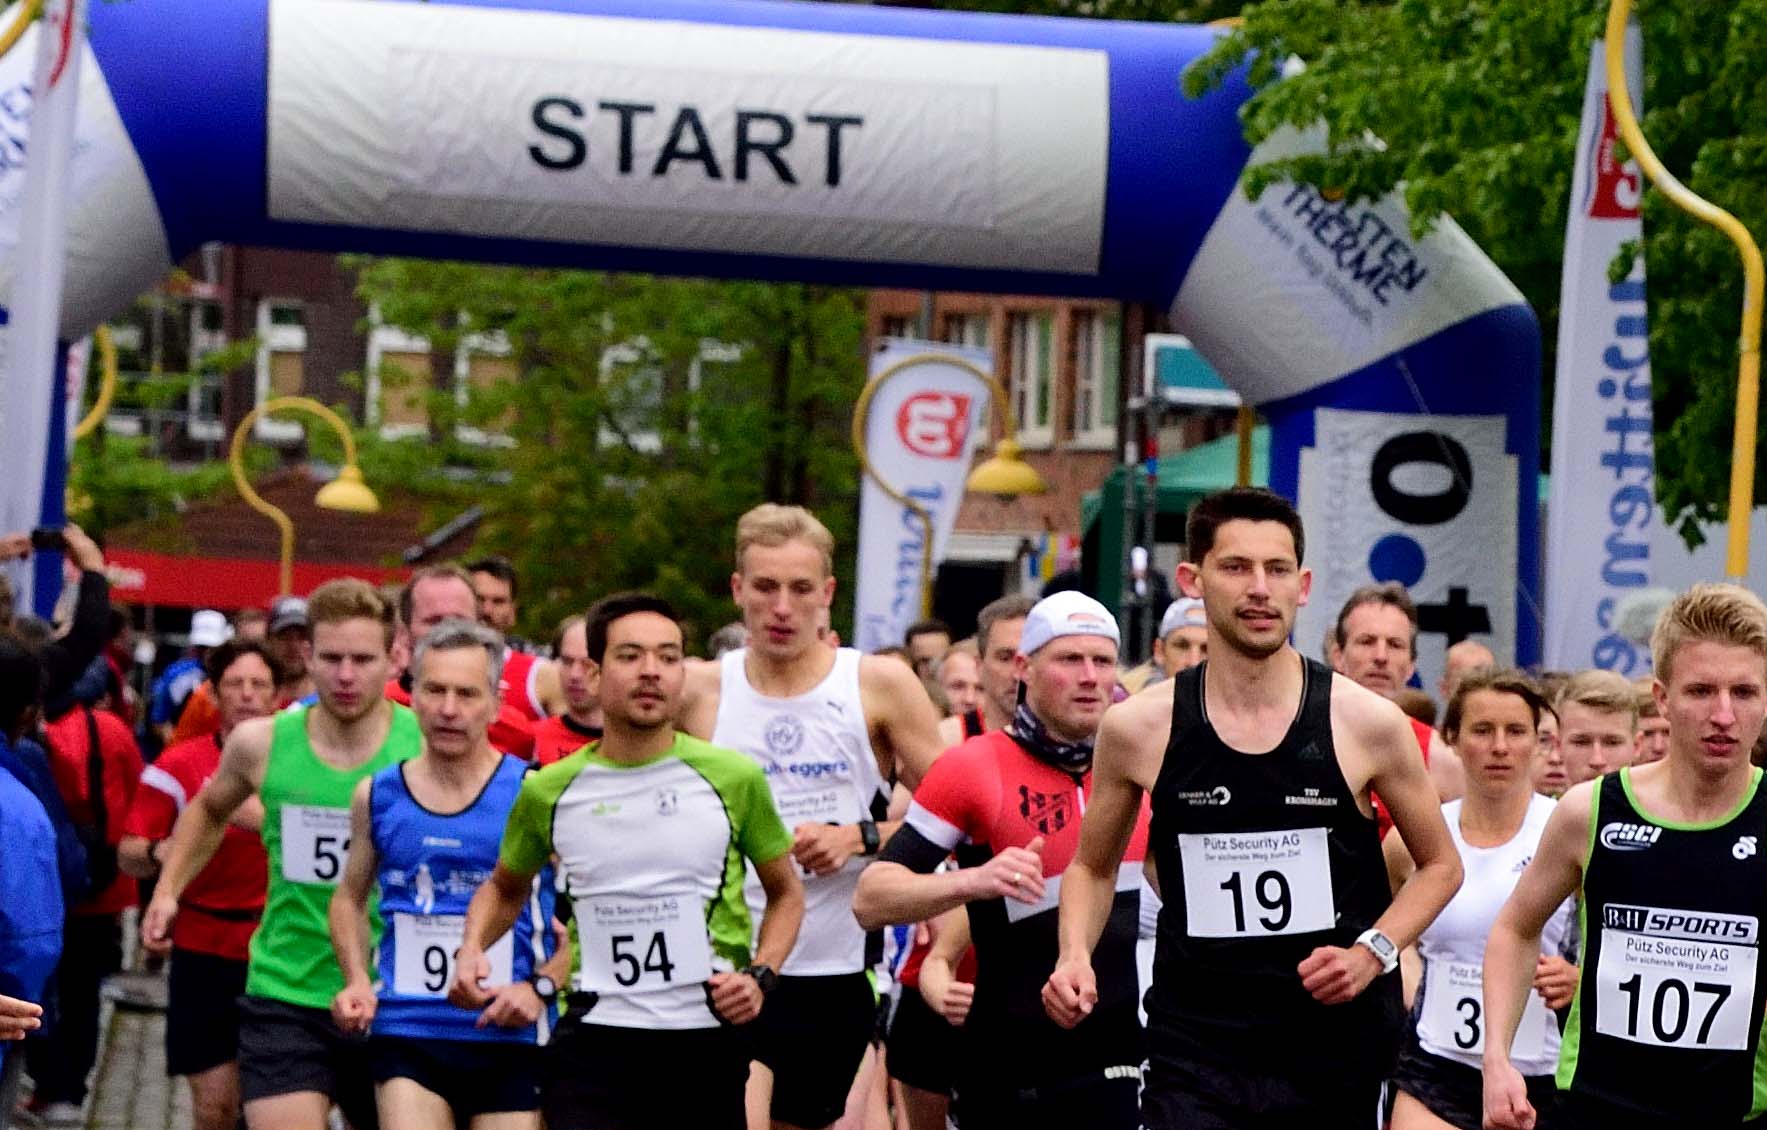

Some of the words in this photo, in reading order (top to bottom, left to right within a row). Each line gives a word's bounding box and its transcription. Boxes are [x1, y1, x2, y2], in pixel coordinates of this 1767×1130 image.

[529, 97, 863, 187] START
[314, 836, 350, 881] 5
[1203, 836, 1227, 851] Pütz
[1229, 835, 1280, 851] Security
[1281, 833, 1301, 847] AG
[1220, 870, 1293, 933] 19
[1626, 937, 1653, 954] Pütz
[1656, 940, 1708, 961] Security
[1709, 947, 1730, 961] AG
[1649, 914, 1753, 938] SPORTS
[424, 945, 461, 992] 9
[611, 931, 675, 987] 54
[1625, 953, 1640, 963] Der
[1641, 955, 1675, 968] sicherste
[1676, 960, 1694, 971] Weg
[1695, 962, 1713, 971] zum
[1713, 963, 1728, 973] Ziel
[1618, 974, 1732, 1044] 107
